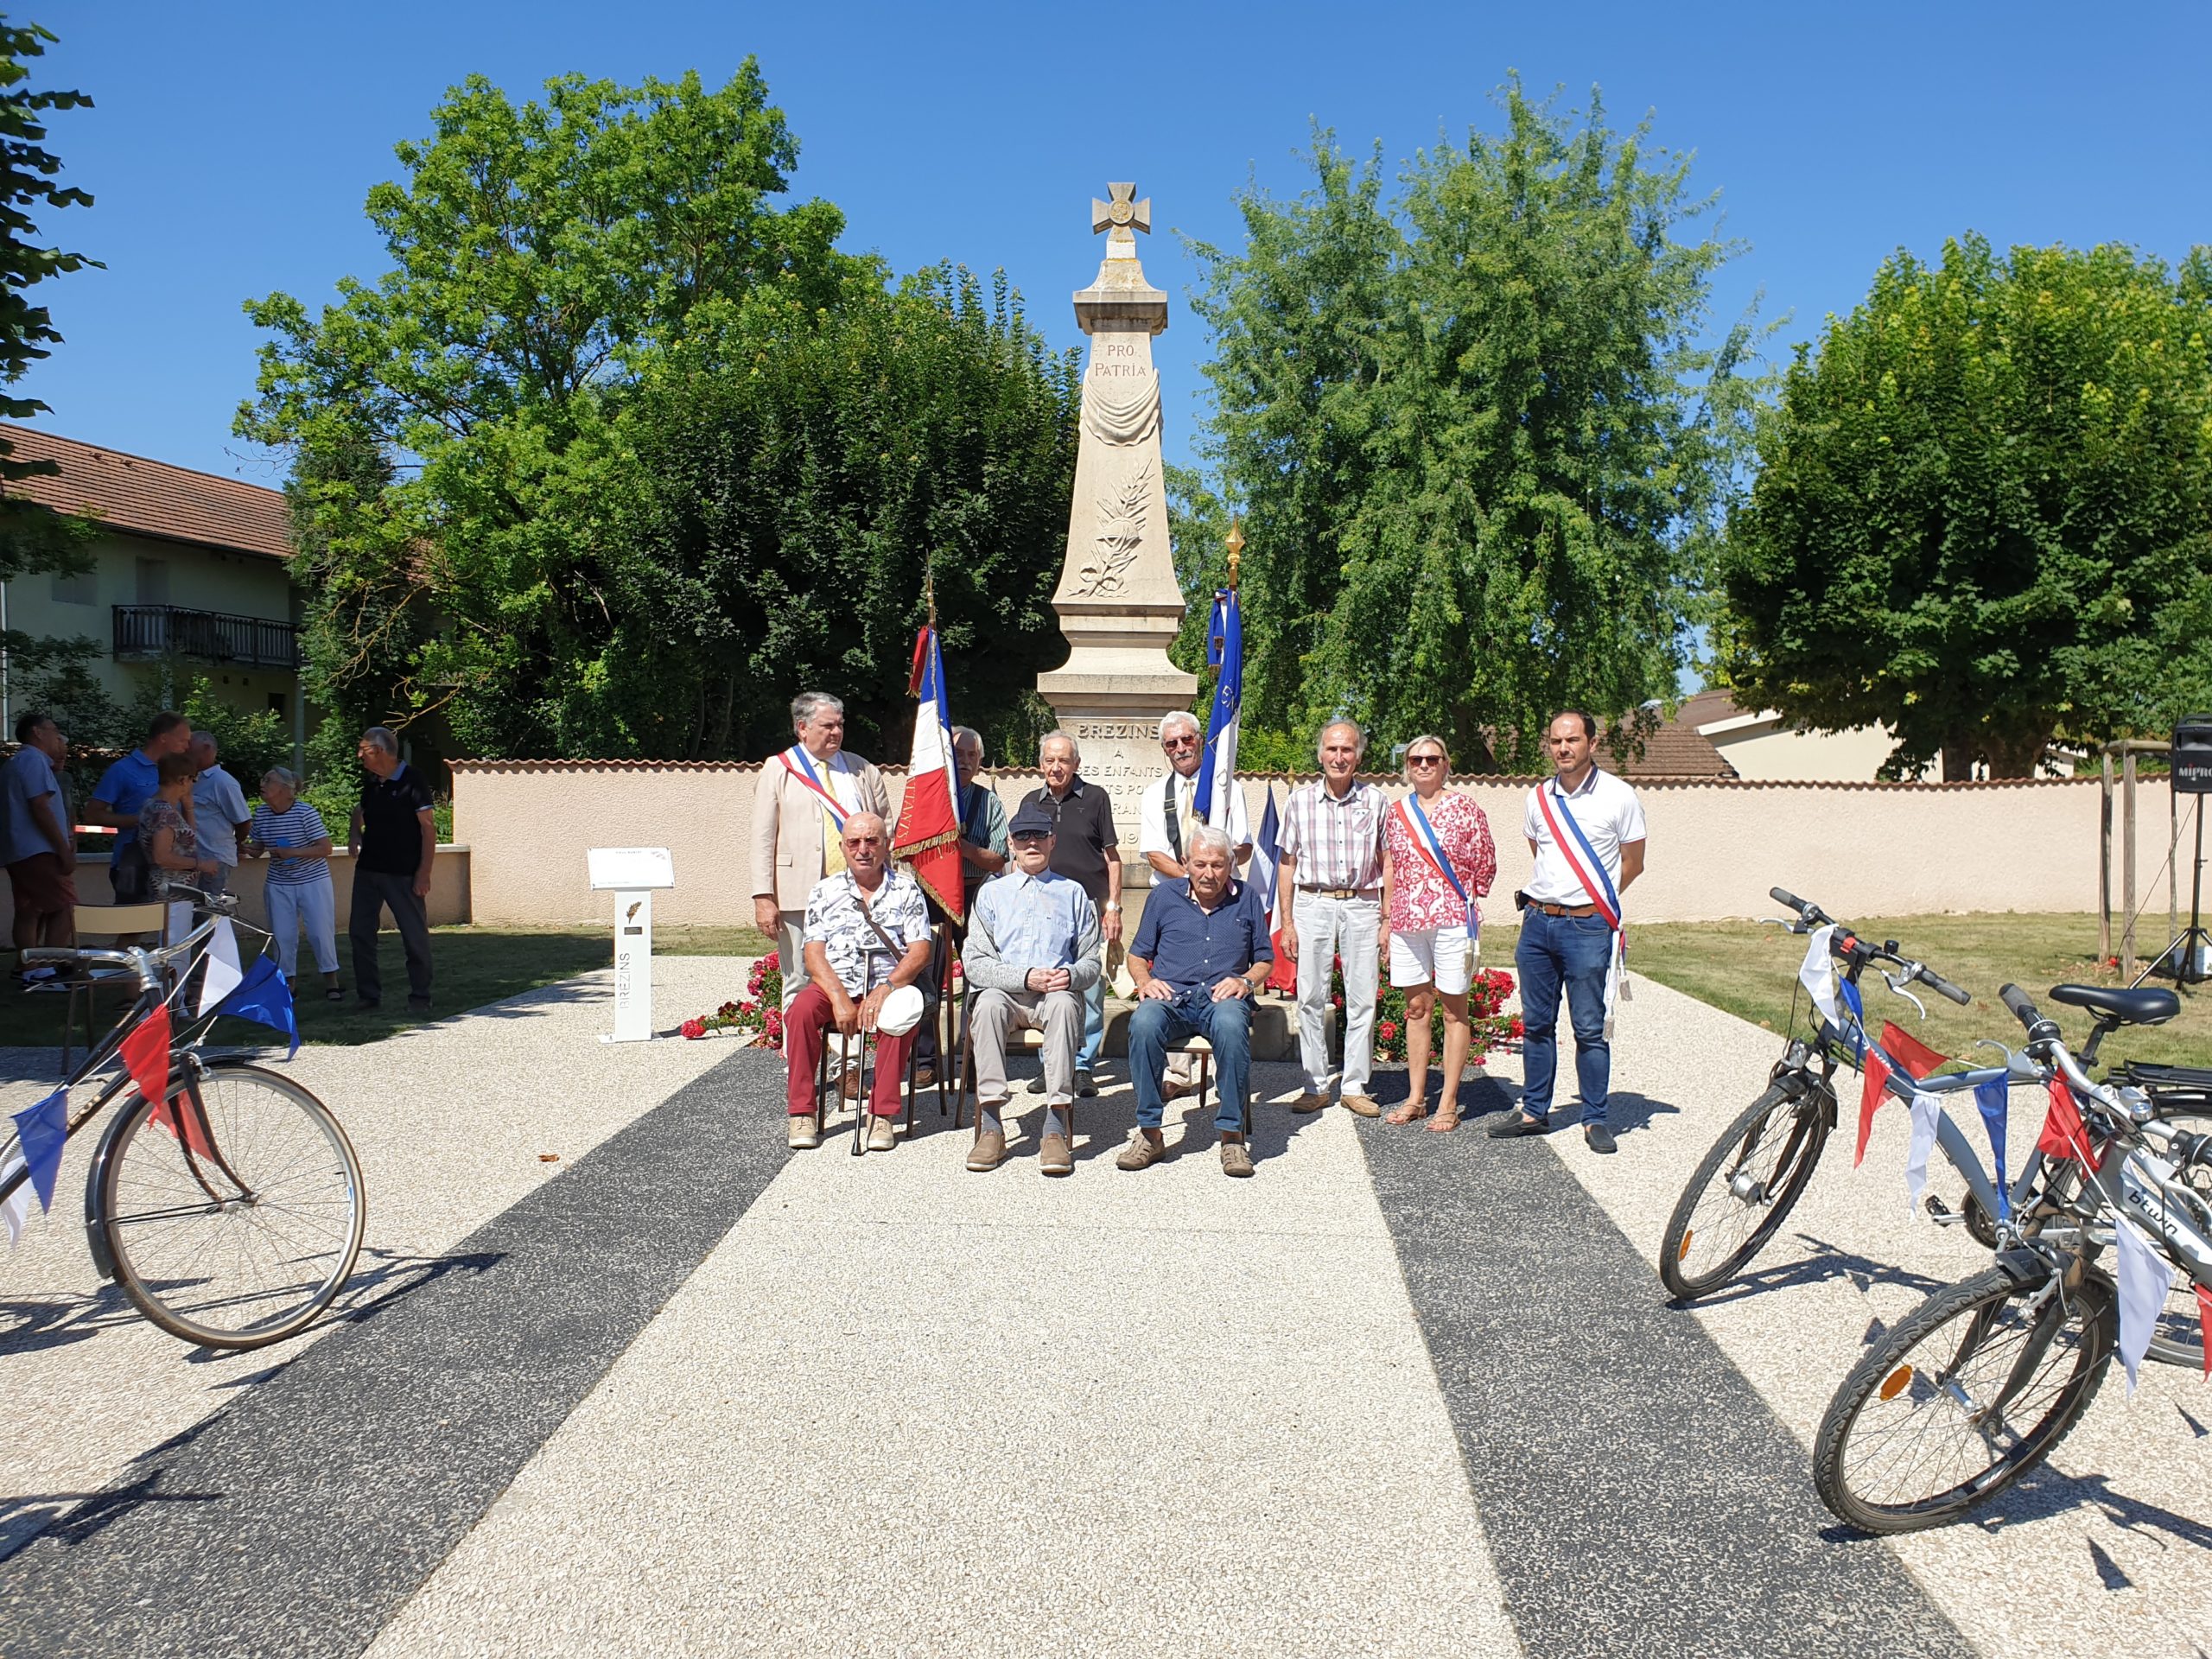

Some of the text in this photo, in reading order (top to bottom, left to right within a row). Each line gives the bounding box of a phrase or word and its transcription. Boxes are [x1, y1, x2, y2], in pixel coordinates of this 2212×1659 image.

[1108, 344, 1135, 357] PRO
[1095, 362, 1147, 377] PATRIA
[1104, 766, 1163, 778] ENFANTS
[1127, 785, 1147, 796] PO
